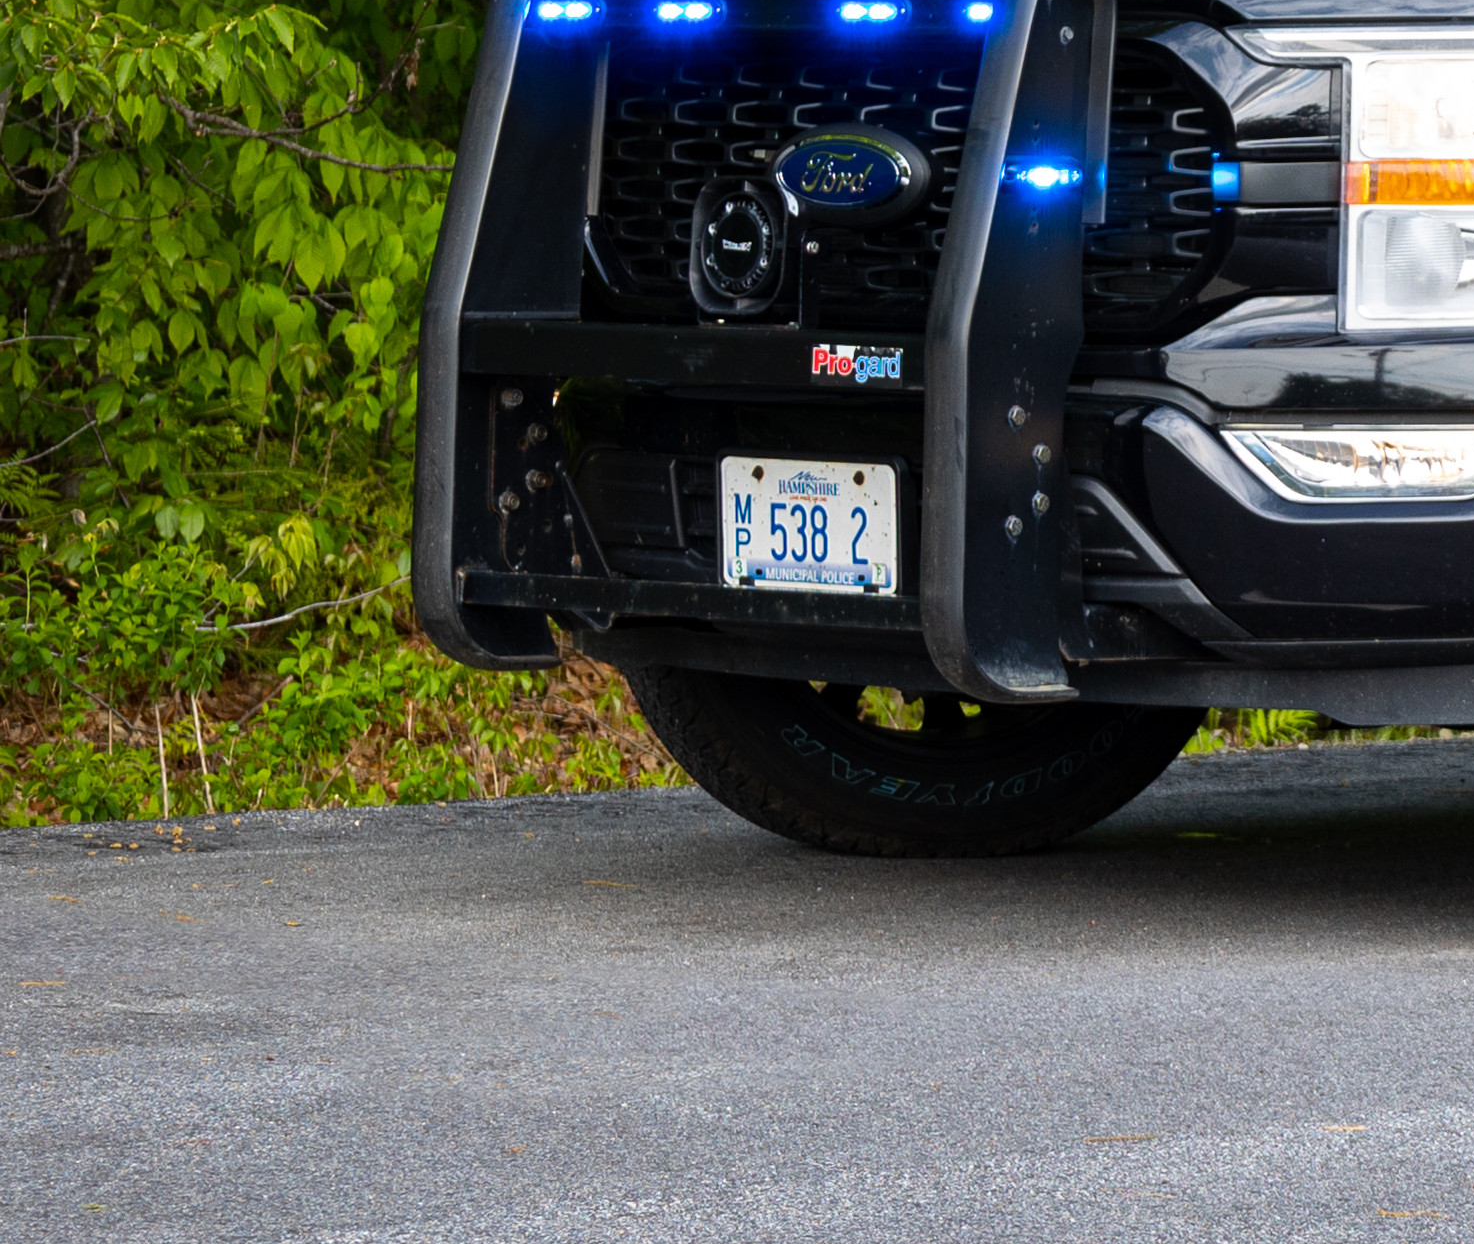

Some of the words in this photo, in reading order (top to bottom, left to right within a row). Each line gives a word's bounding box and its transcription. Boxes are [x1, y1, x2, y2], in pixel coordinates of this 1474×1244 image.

[801, 150, 873, 194] Ford
[778, 479, 840, 497] HAMPSHIRE
[770, 502, 828, 563] 538
[851, 506, 868, 565] 2
[765, 567, 818, 583] MUNICIPAL
[821, 569, 854, 585] POLICE
